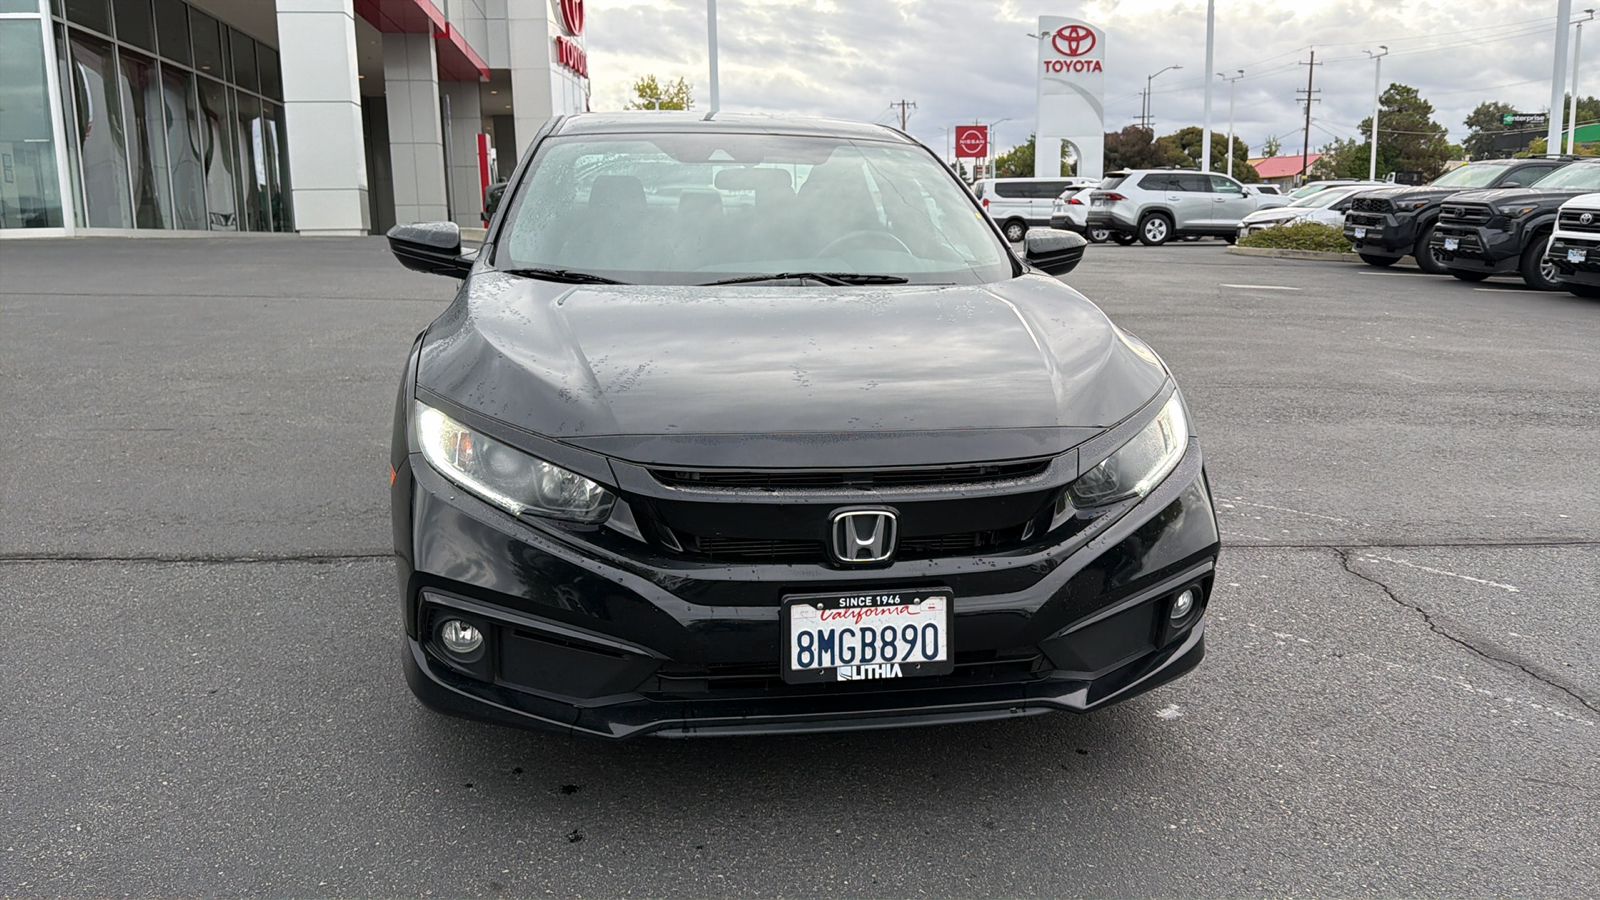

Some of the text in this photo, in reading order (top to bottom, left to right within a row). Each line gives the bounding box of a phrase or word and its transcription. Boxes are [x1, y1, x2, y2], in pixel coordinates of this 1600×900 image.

[1044, 60, 1103, 73] TOYOTA
[839, 595, 900, 607] SINCE 1946
[820, 604, 920, 624] California
[797, 622, 939, 668] 8MGB890
[852, 663, 903, 680] LITHIA
